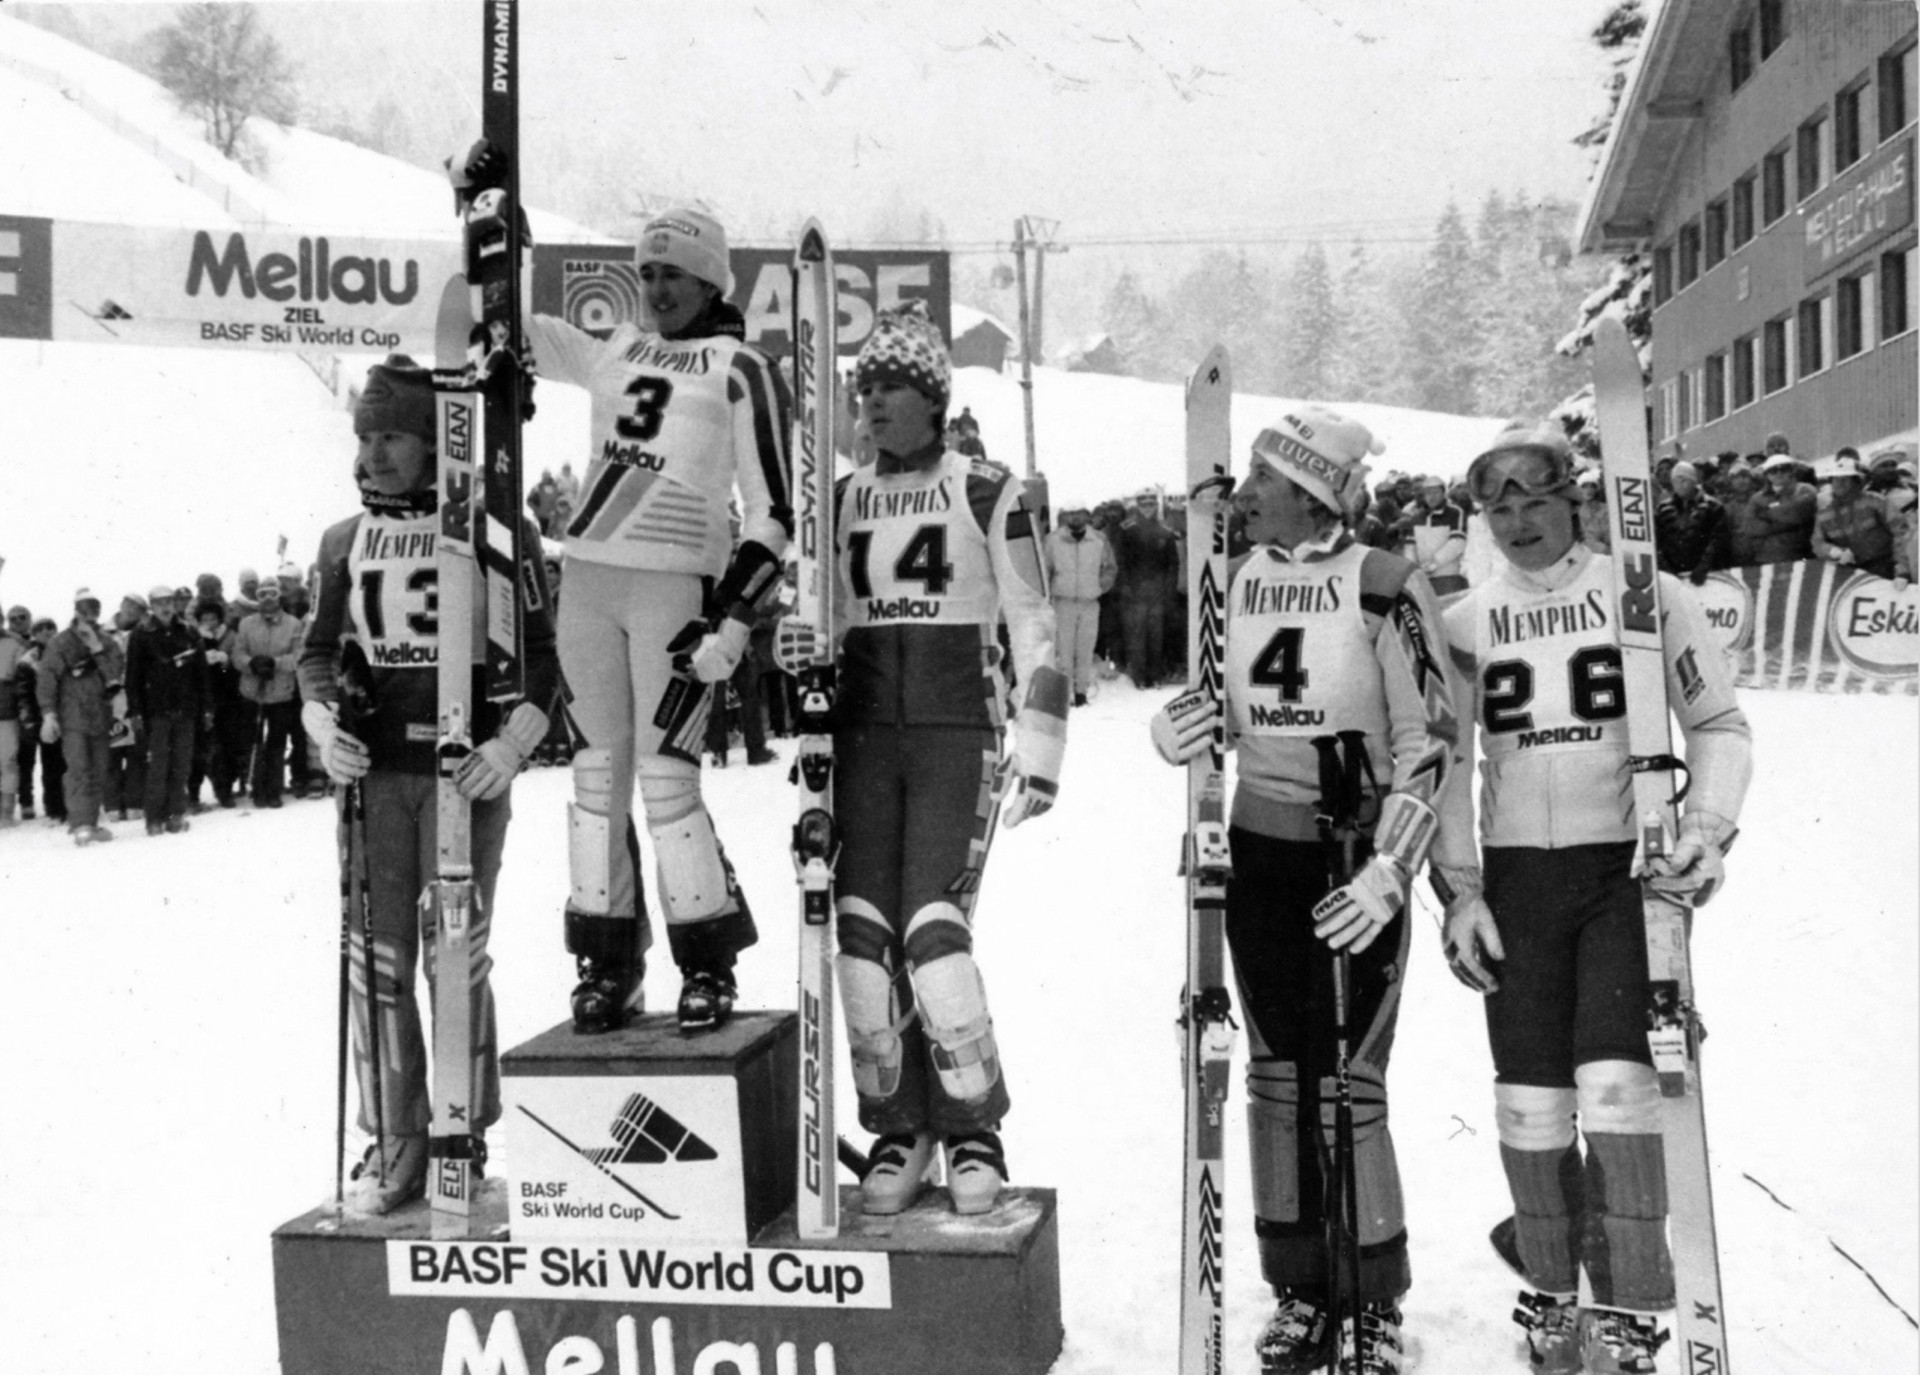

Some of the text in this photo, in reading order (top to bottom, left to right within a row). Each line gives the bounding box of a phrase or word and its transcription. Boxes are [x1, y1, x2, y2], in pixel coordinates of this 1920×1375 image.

[185, 230, 419, 306] Mellau
[566, 262, 599, 274] BASF
[201, 322, 401, 350] BASF Ski World Cup
[283, 307, 325, 324] ZIEL
[616, 377, 672, 441] 3
[602, 439, 666, 473] Mellau
[801, 318, 817, 559] DYNASTAR
[441, 401, 472, 544] RC ELAN
[1279, 439, 1338, 482] uvex
[854, 475, 952, 522] MEMPHIS
[360, 527, 436, 562] MEMPH
[847, 523, 954, 597] 14
[1620, 477, 1657, 634] RC ELAN
[359, 567, 438, 639] 13
[867, 598, 941, 620] Mellau
[1239, 575, 1342, 617] MEMPHIS
[1489, 589, 1607, 648] MEMPHIS
[372, 643, 438, 665] Mellau
[1249, 626, 1310, 705] 4
[1482, 643, 1628, 735] 26
[1250, 704, 1325, 727] Mellau
[1518, 725, 1603, 748] Mellau
[804, 990, 818, 1196] COURSE
[443, 1160, 460, 1200] ELA
[521, 1181, 567, 1198] BASF
[522, 1202, 645, 1222] Ski World Cup
[410, 1245, 864, 1303] BASF Ski World Cup
